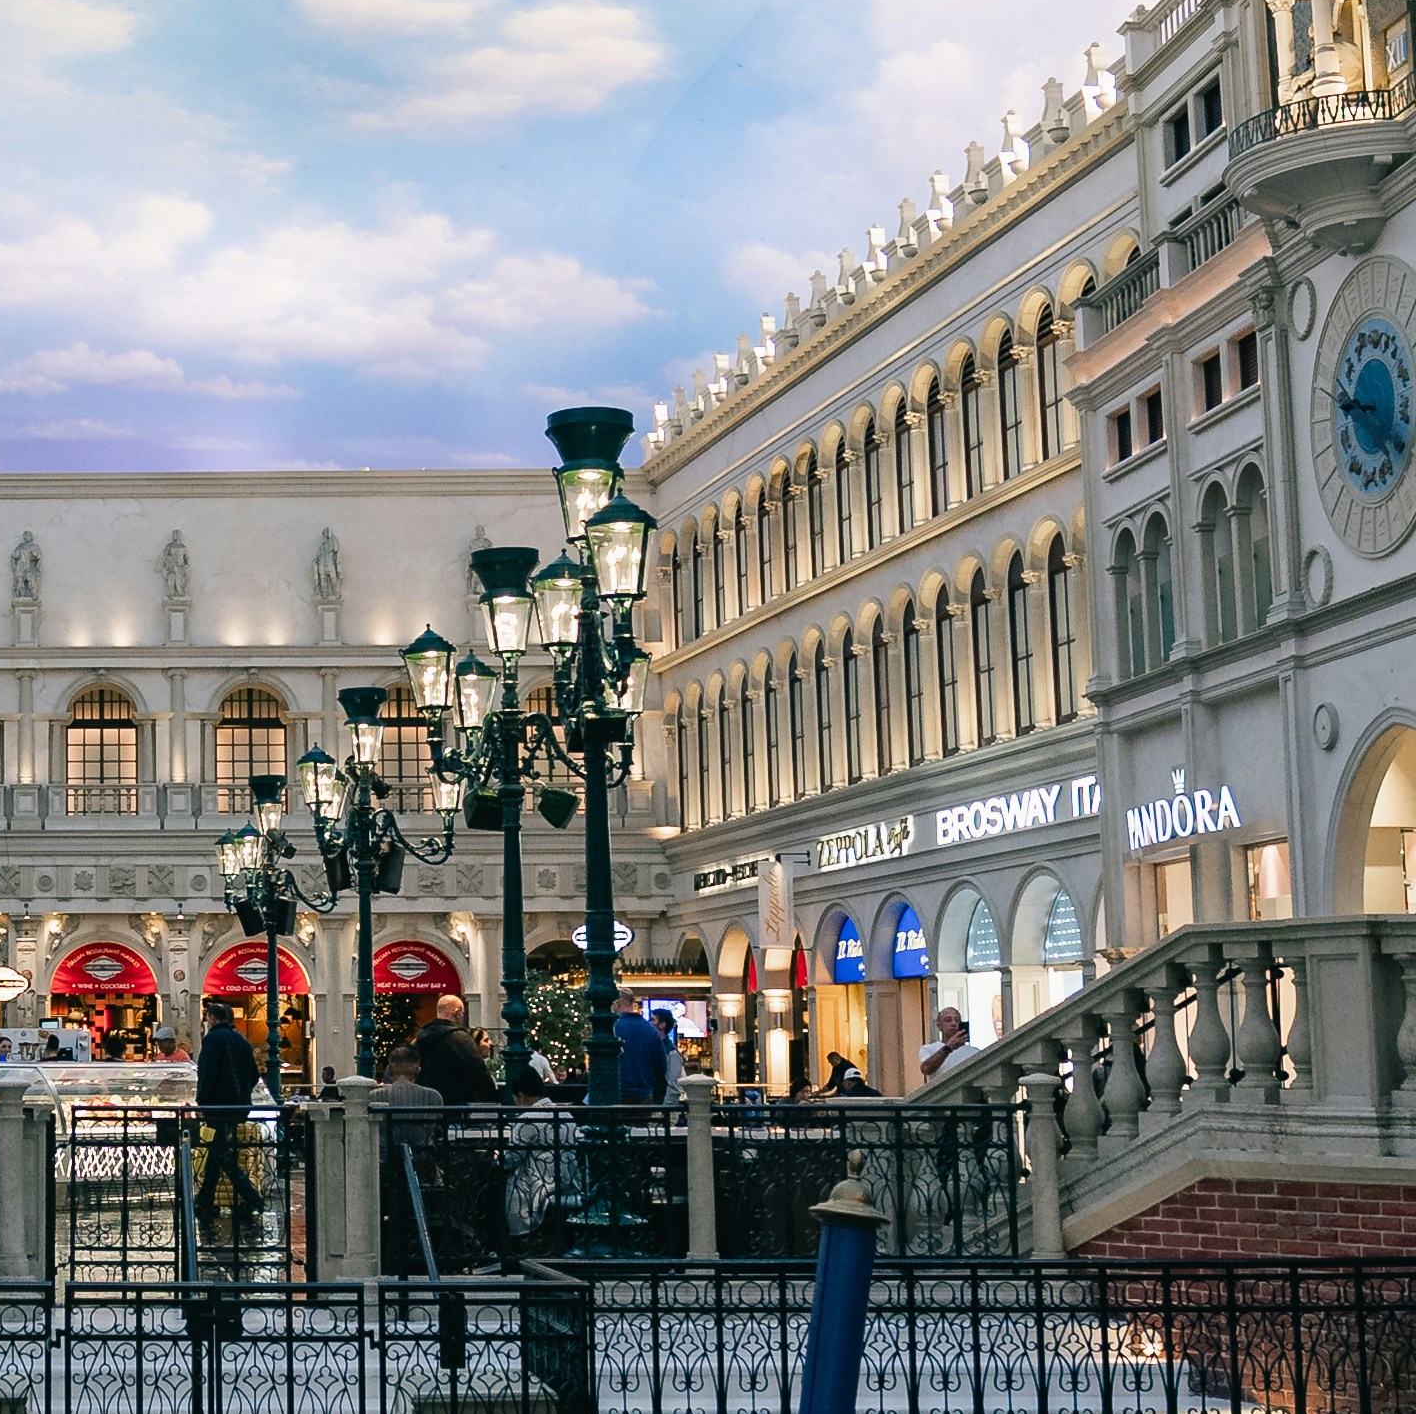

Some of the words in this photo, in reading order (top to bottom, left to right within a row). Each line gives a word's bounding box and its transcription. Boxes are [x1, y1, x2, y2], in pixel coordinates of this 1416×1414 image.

[816, 823, 885, 869] ZEPPOLA
[936, 784, 1060, 846] BROSWAY
[1126, 785, 1241, 851] PANDORA
